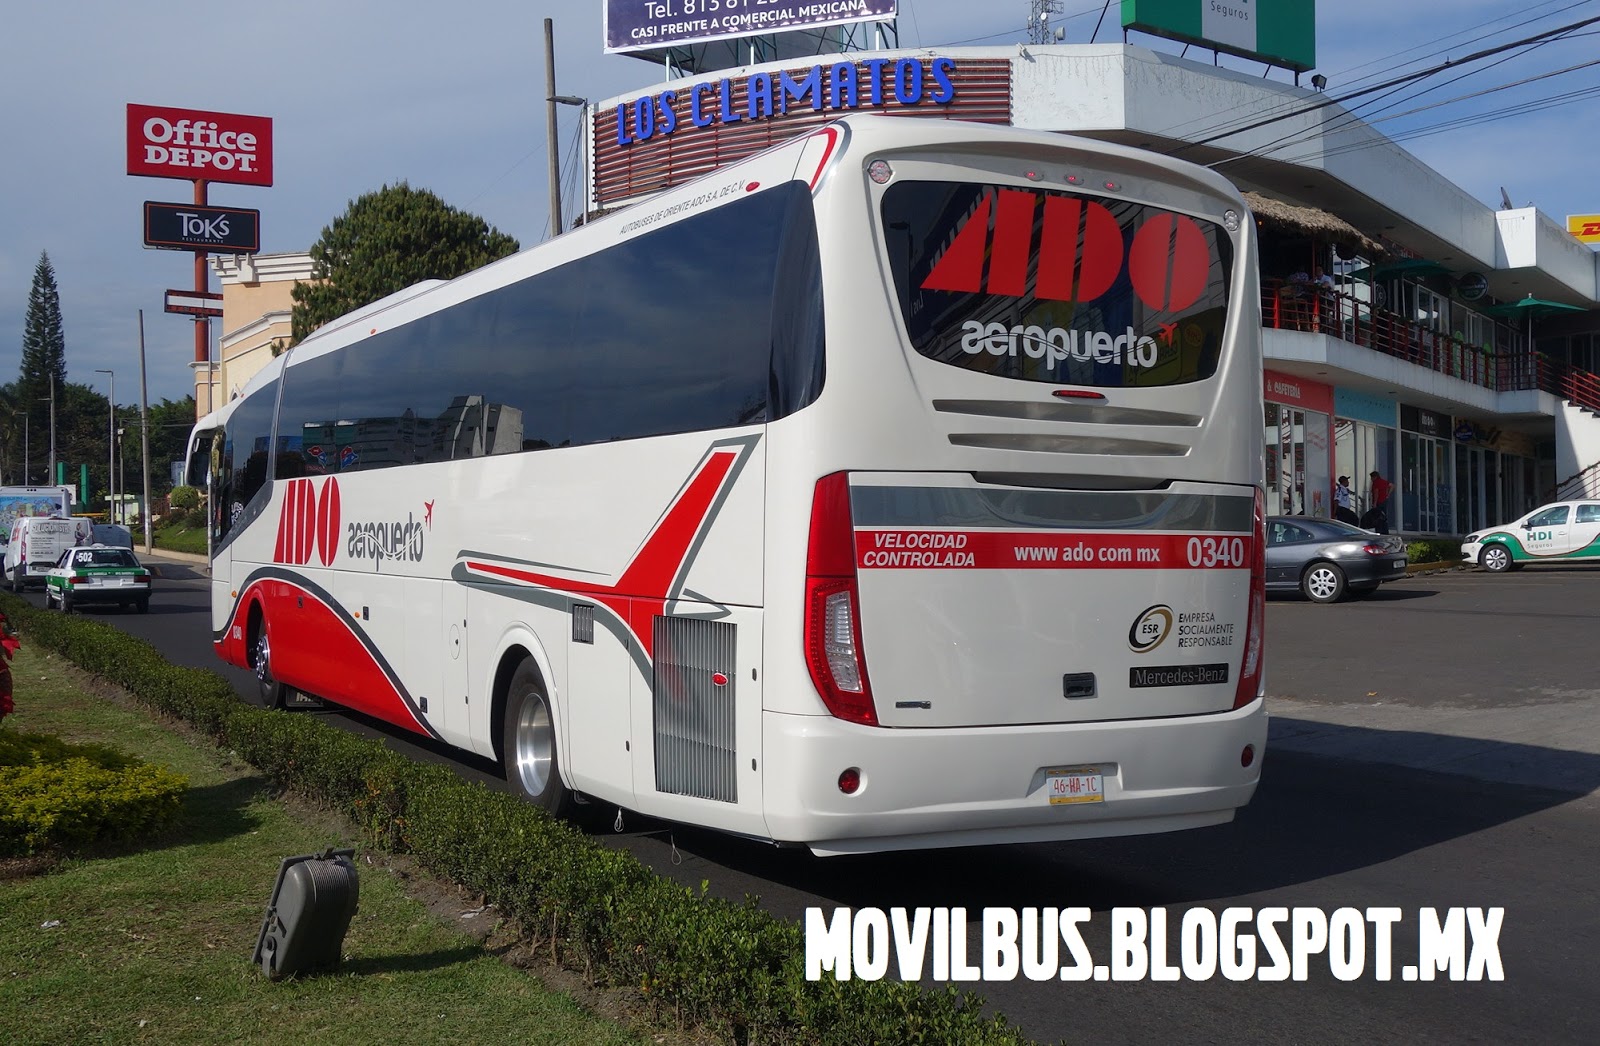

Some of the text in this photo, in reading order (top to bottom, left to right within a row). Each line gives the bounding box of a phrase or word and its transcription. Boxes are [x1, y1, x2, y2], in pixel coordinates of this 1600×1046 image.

[631, 0, 867, 39] CASI FRENTE A COMERCIAL MEXICANA
[645, 2, 677, 19] Tel.
[1211, 1, 1249, 21] Seguros
[617, 57, 957, 146] LOS CLAMATOS
[143, 117, 257, 151] Office
[619, 215, 655, 235] AUTOBUSES
[653, 210, 663, 222] DE
[662, 203, 690, 219] ORIENTE
[690, 194, 706, 209] ADO
[720, 184, 731, 198] DE
[920, 188, 1210, 313] ADO
[961, 320, 1158, 371] aeropuerto
[273, 476, 341, 567] ADO
[348, 512, 424, 572] aeropuerto
[875, 533, 968, 549] VELOCIDAD
[1527, 531, 1552, 542] HDI
[78, 552, 93, 563] 502
[863, 551, 976, 567] CONTROLADA
[1187, 537, 1244, 568] 0340
[1178, 613, 1215, 623] EMPRESA
[1142, 624, 1159, 634] ESR
[1178, 624, 1234, 635] SOCIALMENTE
[1178, 636, 1233, 648] RESPONSABLE
[1134, 667, 1225, 686] Mercedes-Benz
[1054, 776, 1097, 793] 46-HA-1C
